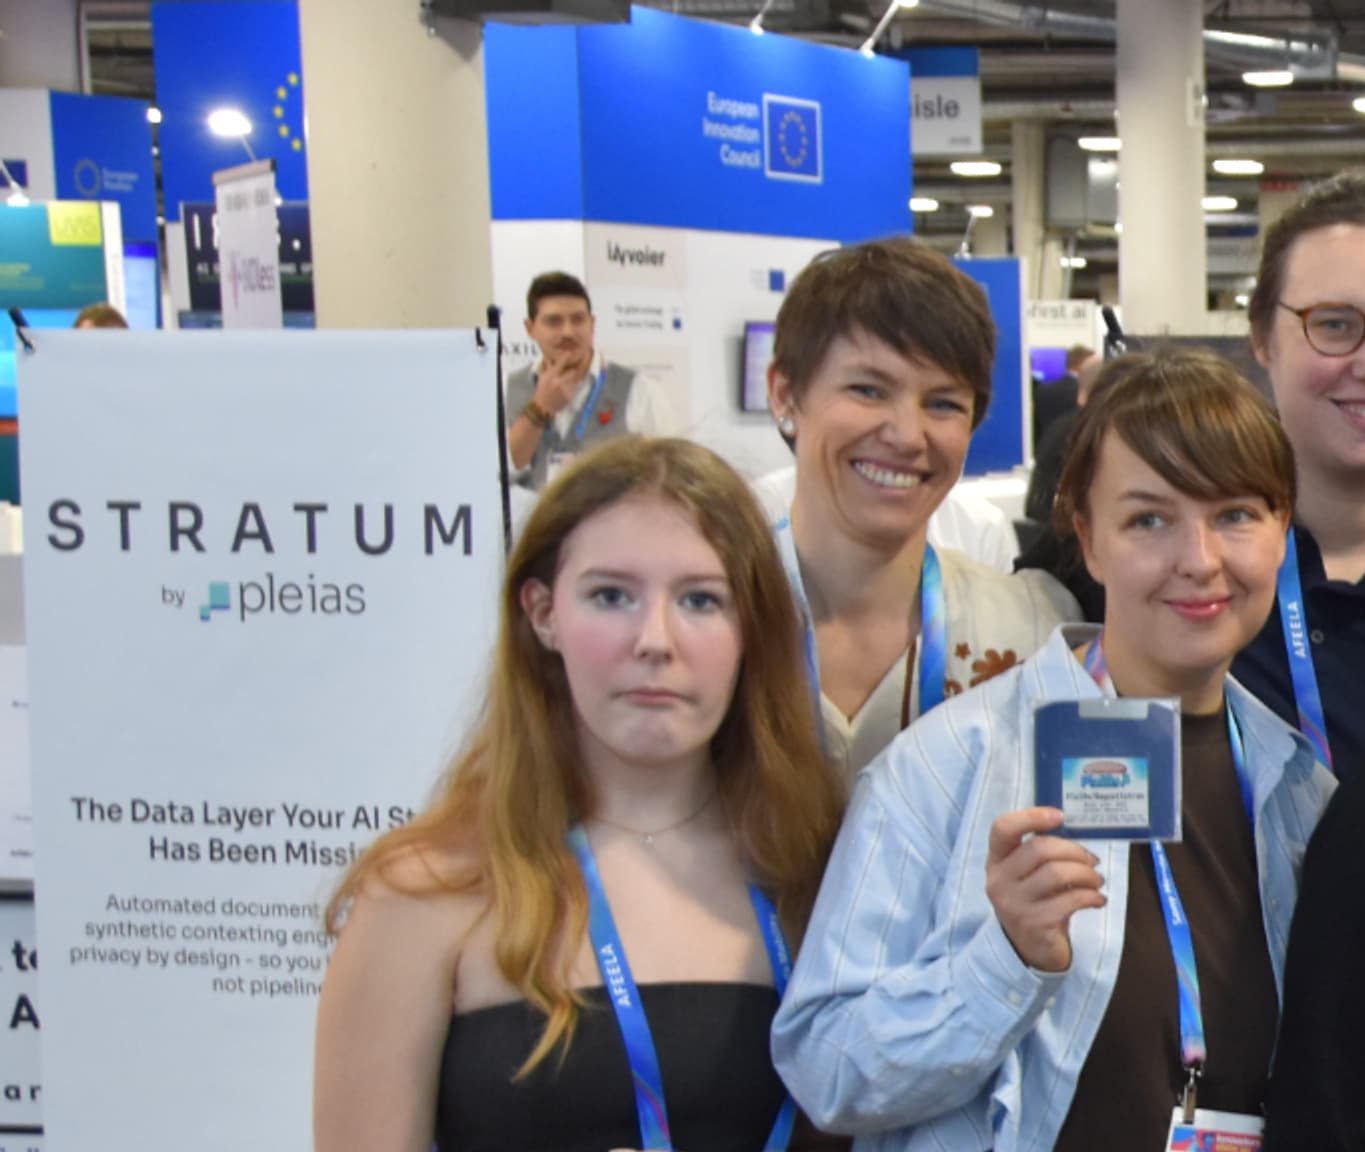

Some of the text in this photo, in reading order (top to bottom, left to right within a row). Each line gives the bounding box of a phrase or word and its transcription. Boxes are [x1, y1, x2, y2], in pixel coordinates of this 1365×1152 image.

[708, 91, 759, 119] European
[910, 94, 960, 119] isle
[703, 117, 760, 143] Innovation
[719, 144, 760, 168] Council
[47, 498, 473, 557] STRATUM
[161, 572, 367, 623] by pleias
[1287, 600, 1308, 659] AFEELA
[71, 797, 123, 823] The
[131, 799, 195, 826] Data
[203, 801, 275, 832] Layer
[282, 803, 345, 830] Your
[352, 805, 380, 831] AI
[149, 836, 201, 863] Has
[209, 838, 277, 865] Been
[105, 894, 321, 920] Automated document
[85, 920, 178, 943] synthetic
[181, 924, 288, 947] contexting
[69, 946, 142, 969] privacy
[147, 948, 171, 970] by
[174, 949, 240, 971] design
[259, 953, 282, 969] so
[286, 954, 321, 974] you
[213, 975, 245, 994] not
[601, 942, 632, 1008] AFEELA
